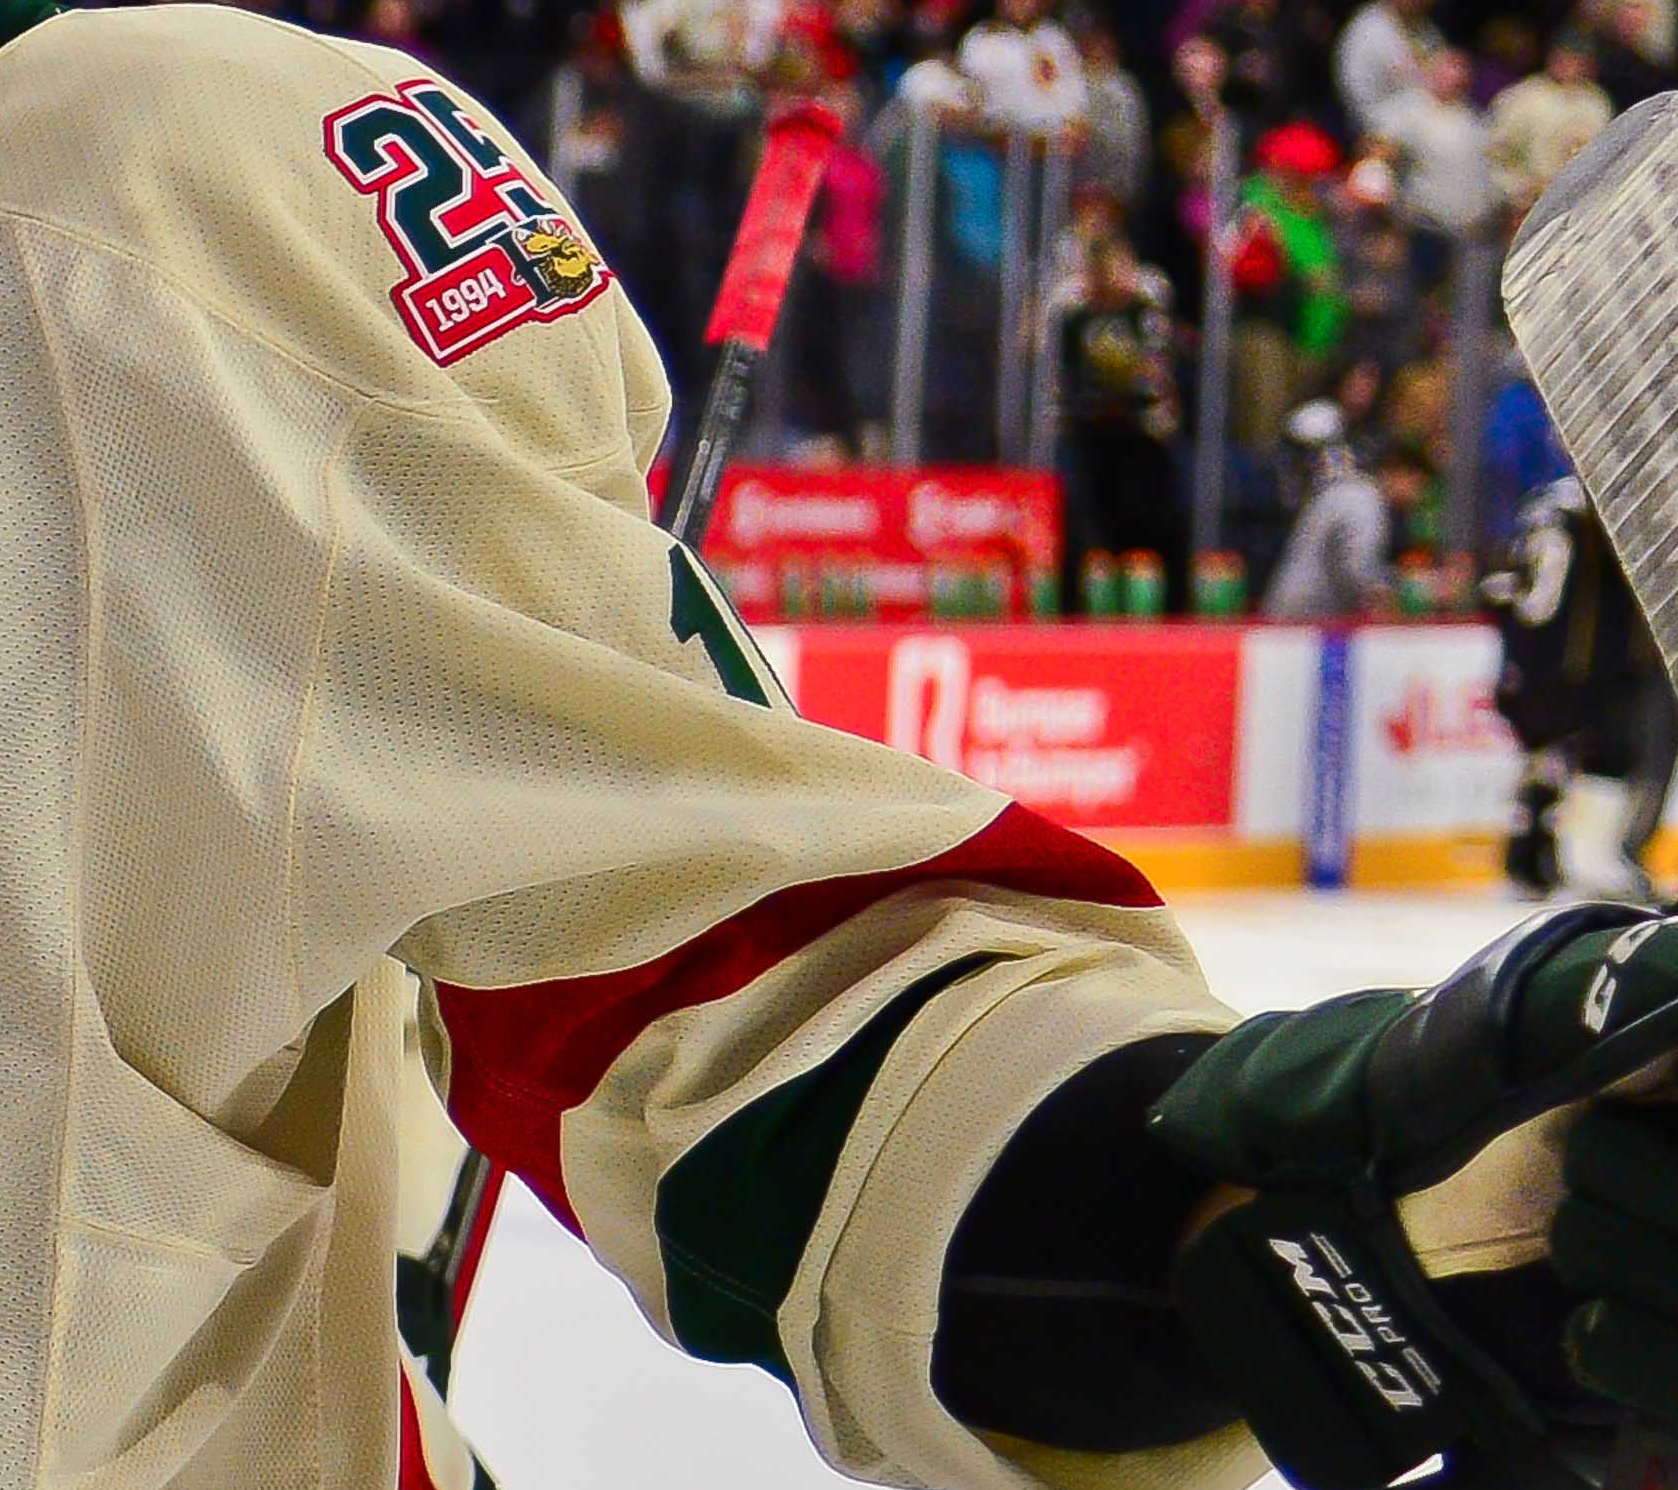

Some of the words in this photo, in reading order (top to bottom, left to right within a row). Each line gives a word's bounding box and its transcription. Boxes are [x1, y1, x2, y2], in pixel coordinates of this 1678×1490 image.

[423, 272, 507, 332] 1994
[1269, 1238, 1423, 1411] CCM
[1345, 1282, 1406, 1344] PRO
